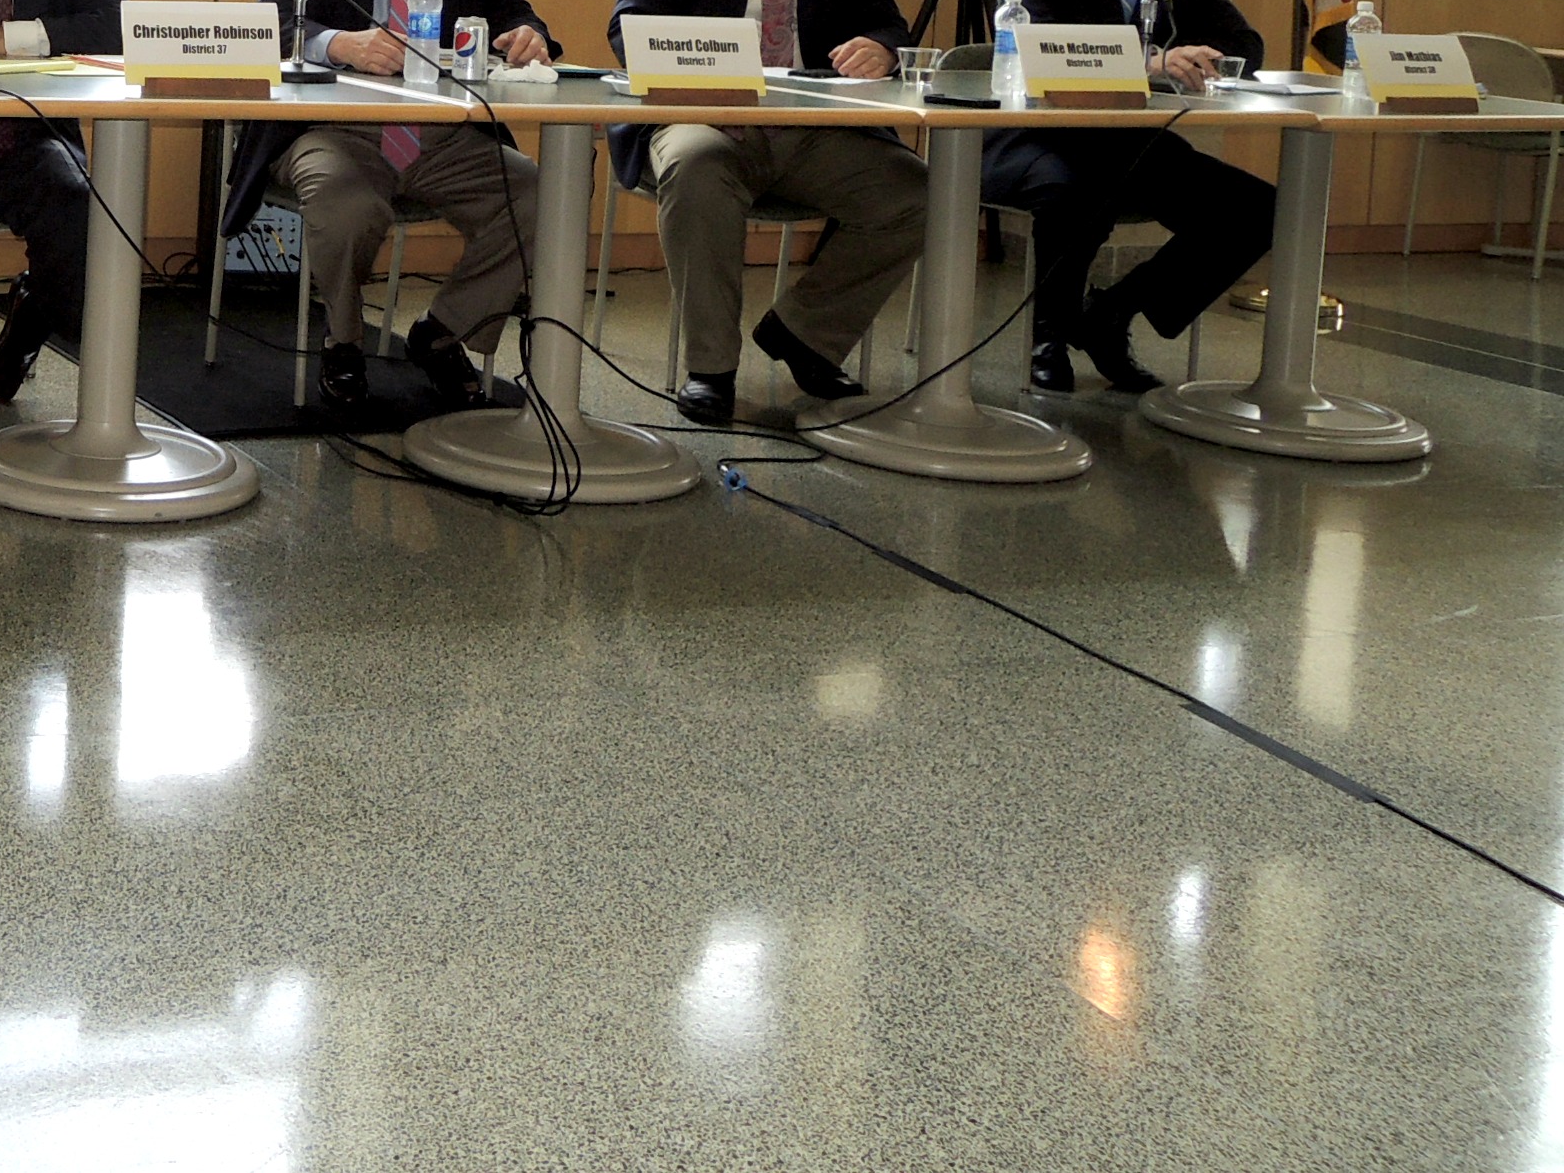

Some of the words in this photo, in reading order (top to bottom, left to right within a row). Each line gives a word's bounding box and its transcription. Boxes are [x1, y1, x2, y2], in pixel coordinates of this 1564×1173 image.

[133, 24, 210, 40] Christopher
[213, 25, 273, 40] Robinson
[182, 43, 215, 54] District
[217, 44, 227, 54] 37
[648, 38, 693, 52] Richard
[695, 39, 739, 53] Colburn
[1040, 42, 1065, 54] Mike
[1067, 42, 1124, 56] McDermott
[677, 56, 705, 66] District
[707, 57, 716, 66] 37
